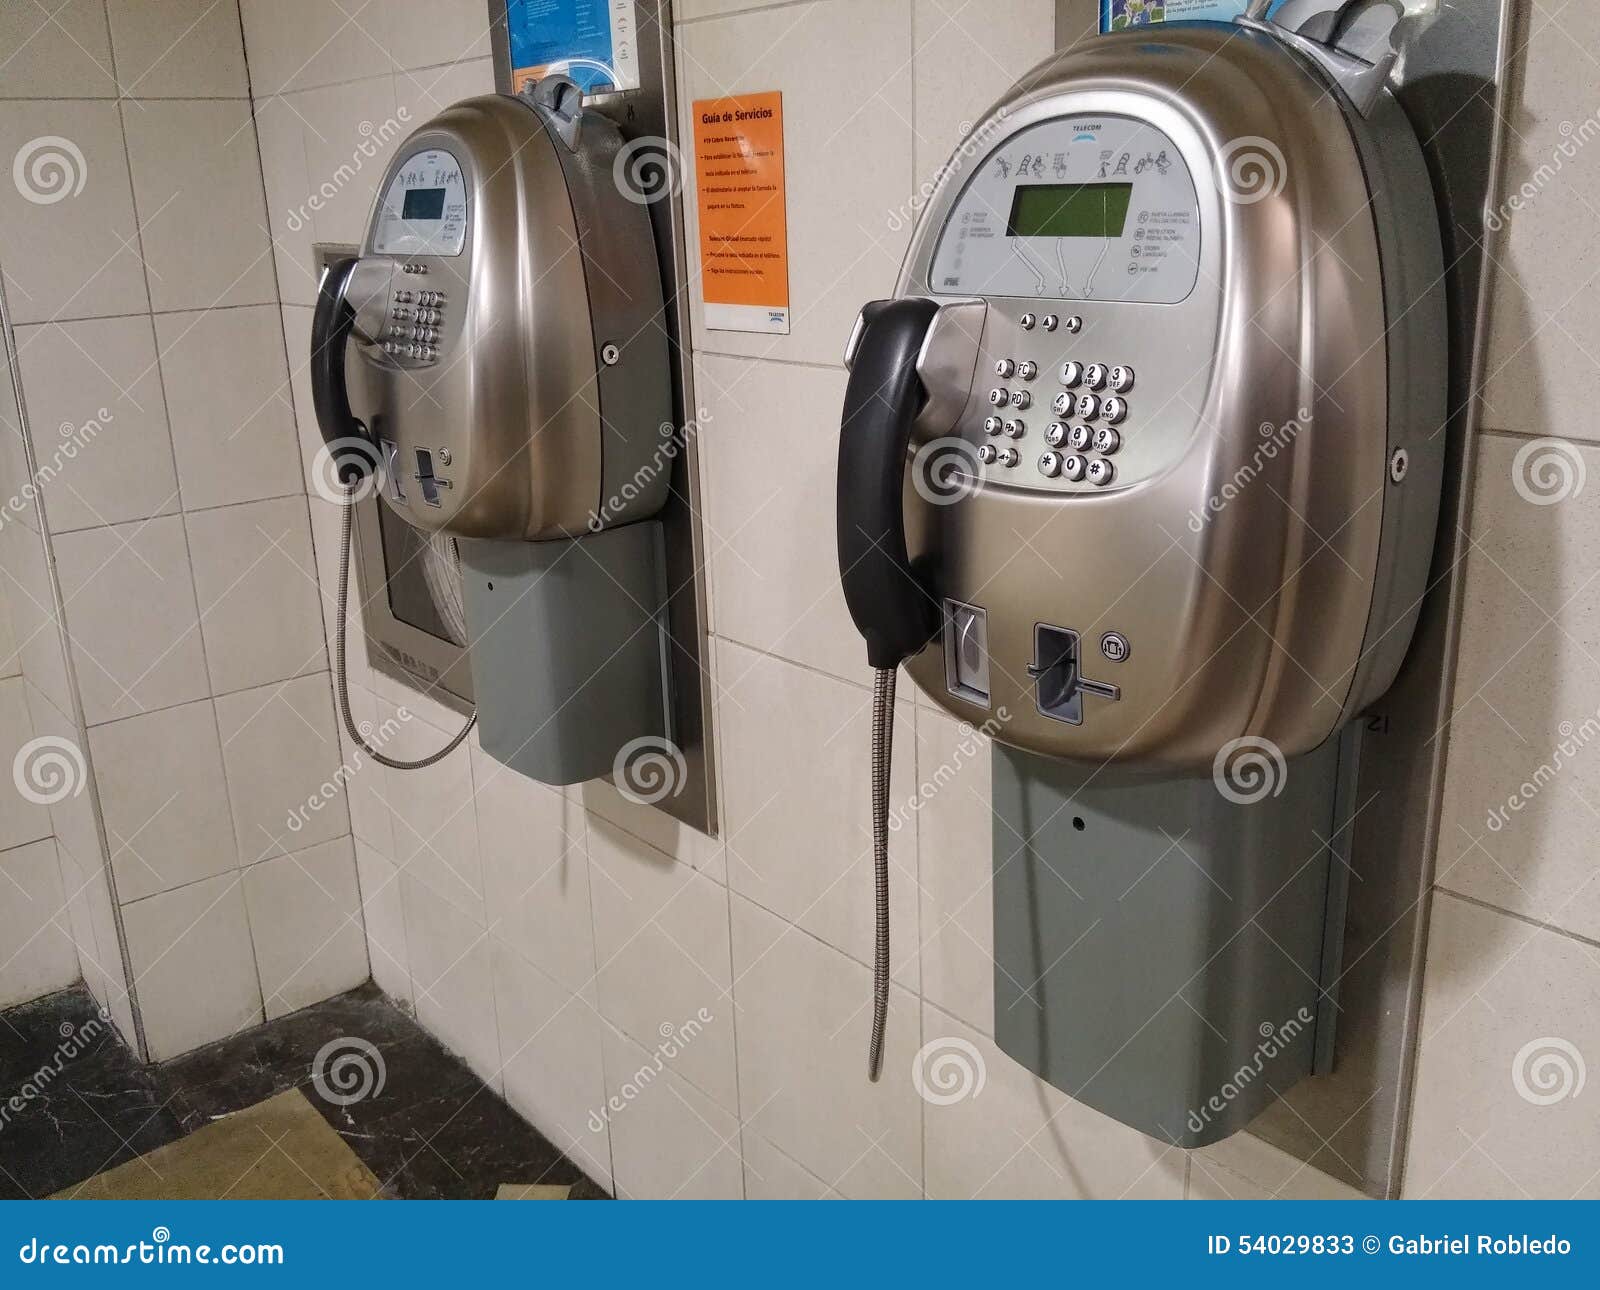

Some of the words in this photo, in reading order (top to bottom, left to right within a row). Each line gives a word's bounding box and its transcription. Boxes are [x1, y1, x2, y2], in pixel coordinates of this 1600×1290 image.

[723, 111, 733, 121] de
[735, 107, 773, 121] Servicios
[1017, 364, 1029, 375] FC
[1087, 366, 1096, 379] 2
[1112, 368, 1121, 381] 3
[990, 391, 998, 402] B
[1011, 393, 1022, 404] RD
[1080, 396, 1089, 409] 5
[1105, 399, 1113, 412] 6
[1050, 424, 1058, 436] 7
[1073, 427, 1082, 440] 8
[1098, 430, 1107, 443] 9
[1066, 458, 1075, 470] 0
